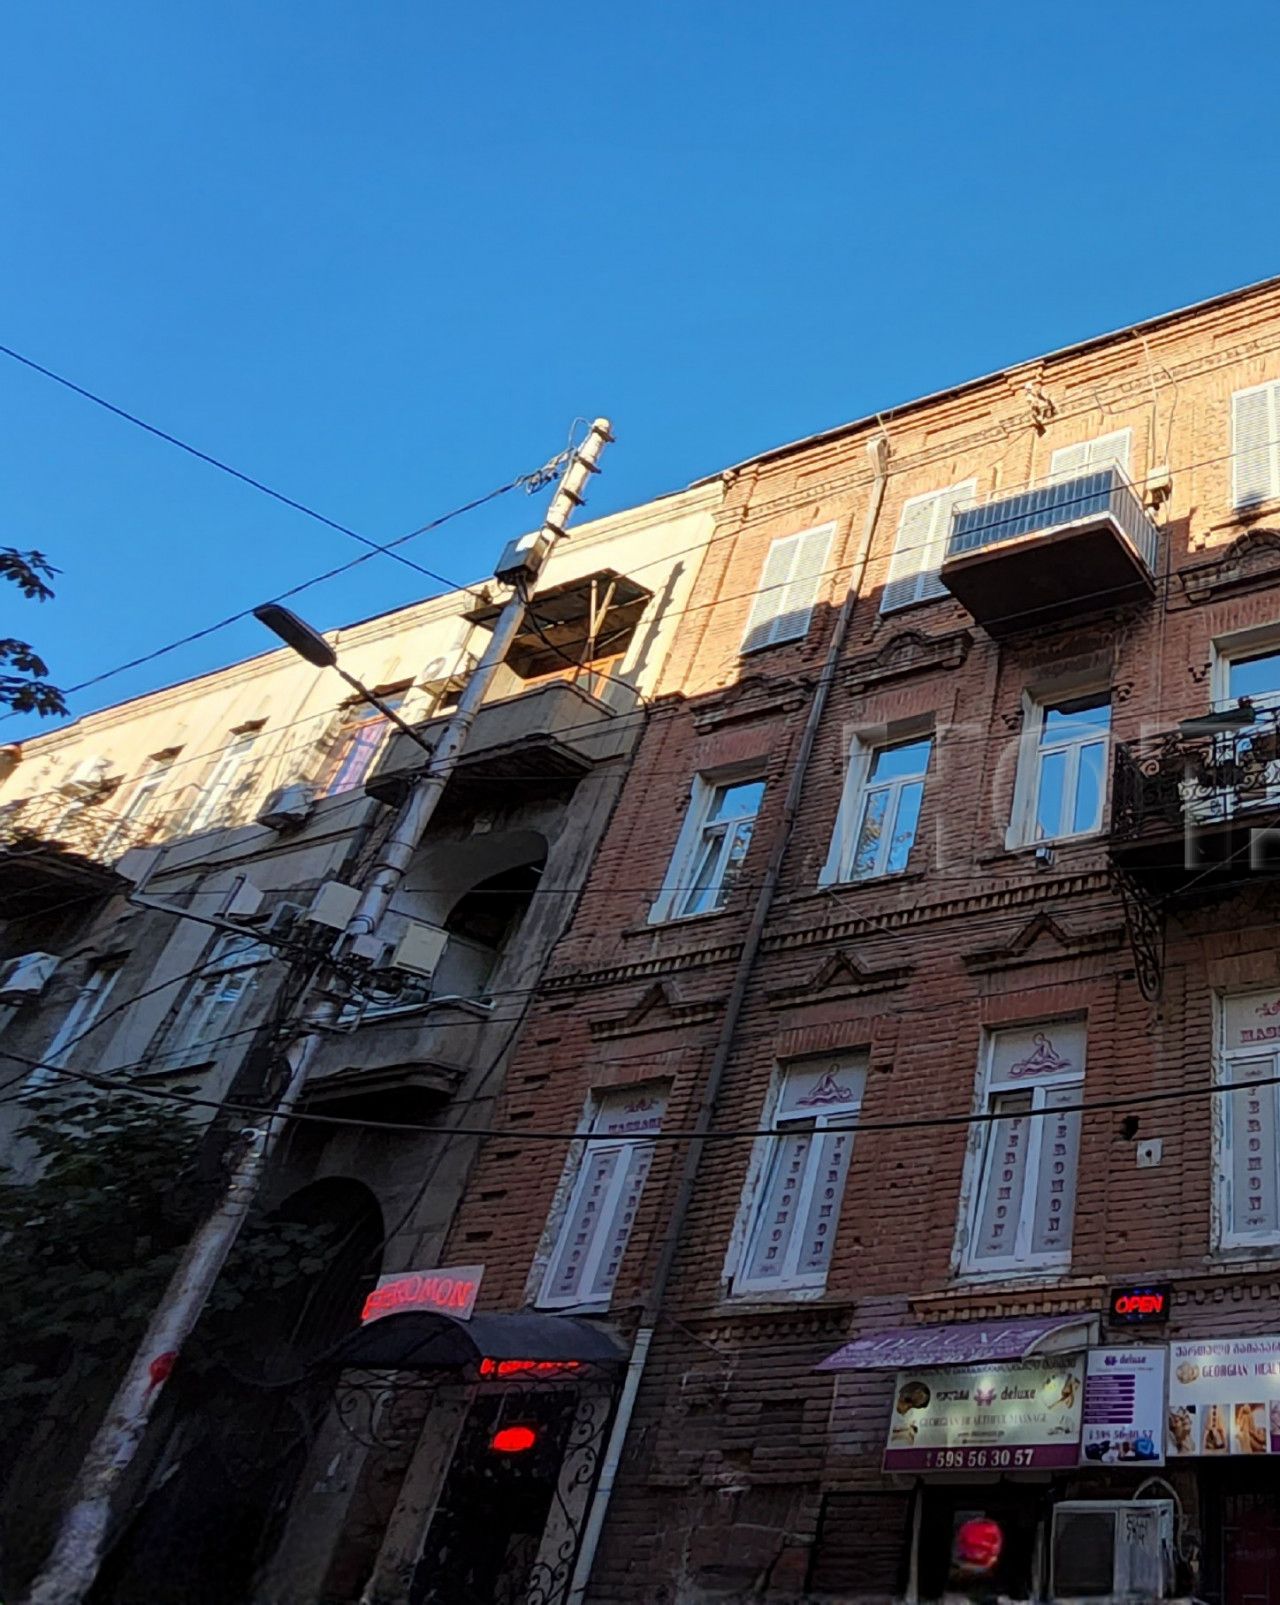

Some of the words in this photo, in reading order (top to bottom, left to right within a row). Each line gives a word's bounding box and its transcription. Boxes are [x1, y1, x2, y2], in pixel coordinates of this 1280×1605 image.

[1115, 1295, 1164, 1314] OPEN
[1202, 1364, 1248, 1378] GEORGIAN
[1000, 1386, 1036, 1400] deluxe
[936, 1451, 964, 1467] 598
[967, 1451, 986, 1466] 56
[990, 1450, 1010, 1466] 30
[1014, 1449, 1034, 1465] 57
